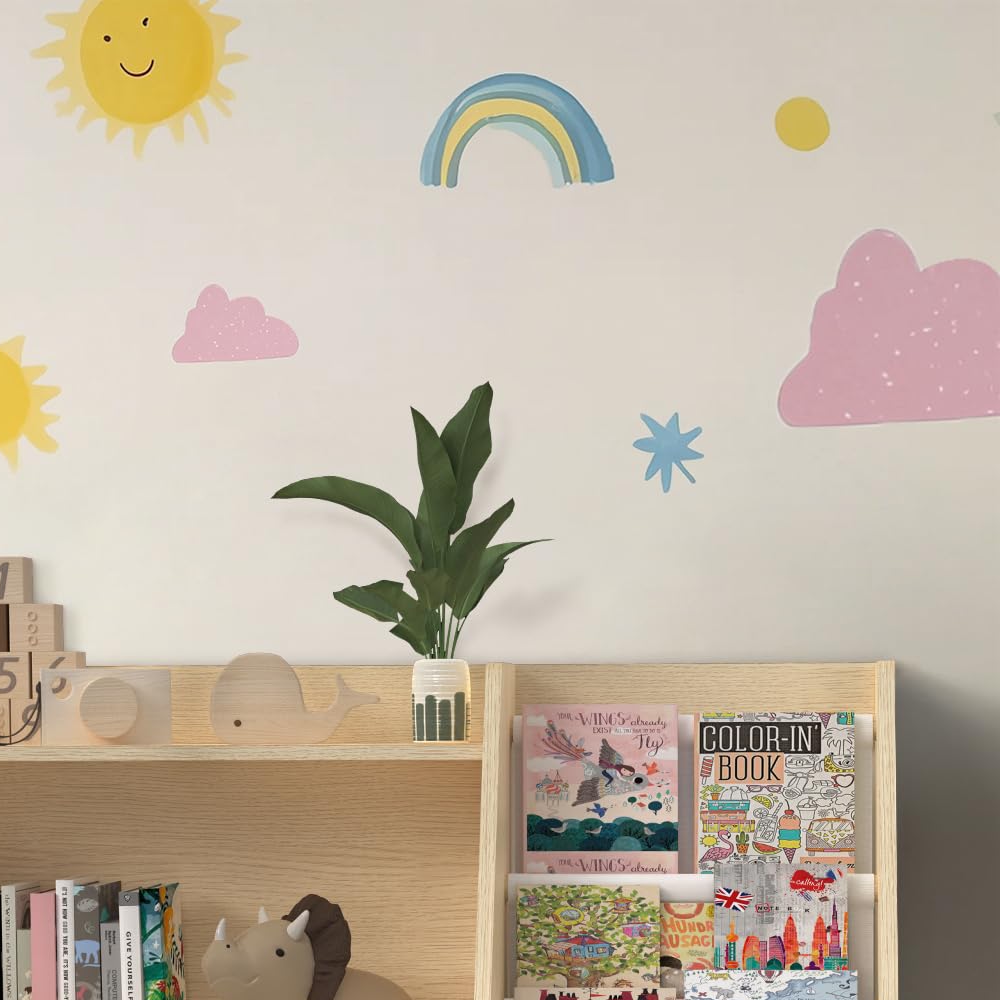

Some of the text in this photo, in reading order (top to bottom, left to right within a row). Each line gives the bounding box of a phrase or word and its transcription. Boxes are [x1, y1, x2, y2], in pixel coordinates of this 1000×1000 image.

[578, 712, 626, 726] WINGS
[630, 716, 666, 729] already
[718, 755, 781, 781] BOOK
[578, 858, 626, 872] WINGS
